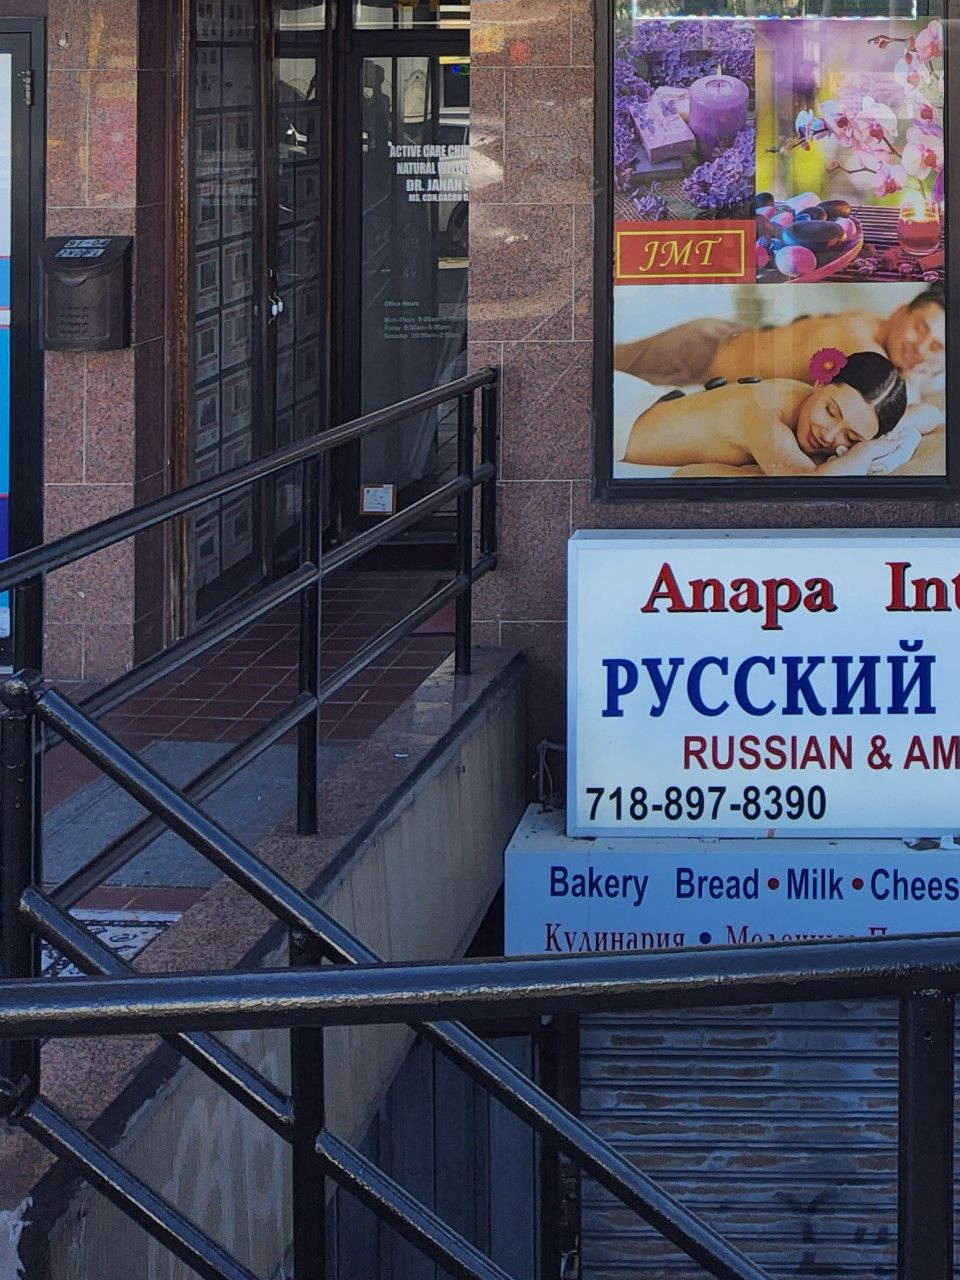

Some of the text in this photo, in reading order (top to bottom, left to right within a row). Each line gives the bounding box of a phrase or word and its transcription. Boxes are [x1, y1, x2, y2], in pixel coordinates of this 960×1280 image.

[389, 144, 421, 158] ACTIVE
[396, 162, 436, 174] NATURAL
[638, 236, 722, 271] JMT
[640, 562, 838, 631] Anapa
[602, 639, 936, 717] РУССКИЙ
[683, 735, 853, 770] RUSSIAN
[867, 735, 893, 770] &
[585, 785, 827, 821] 718-897-8390
[549, 866, 649, 907] Bakery
[676, 867, 759, 900] Bread
[787, 868, 844, 901] Milk
